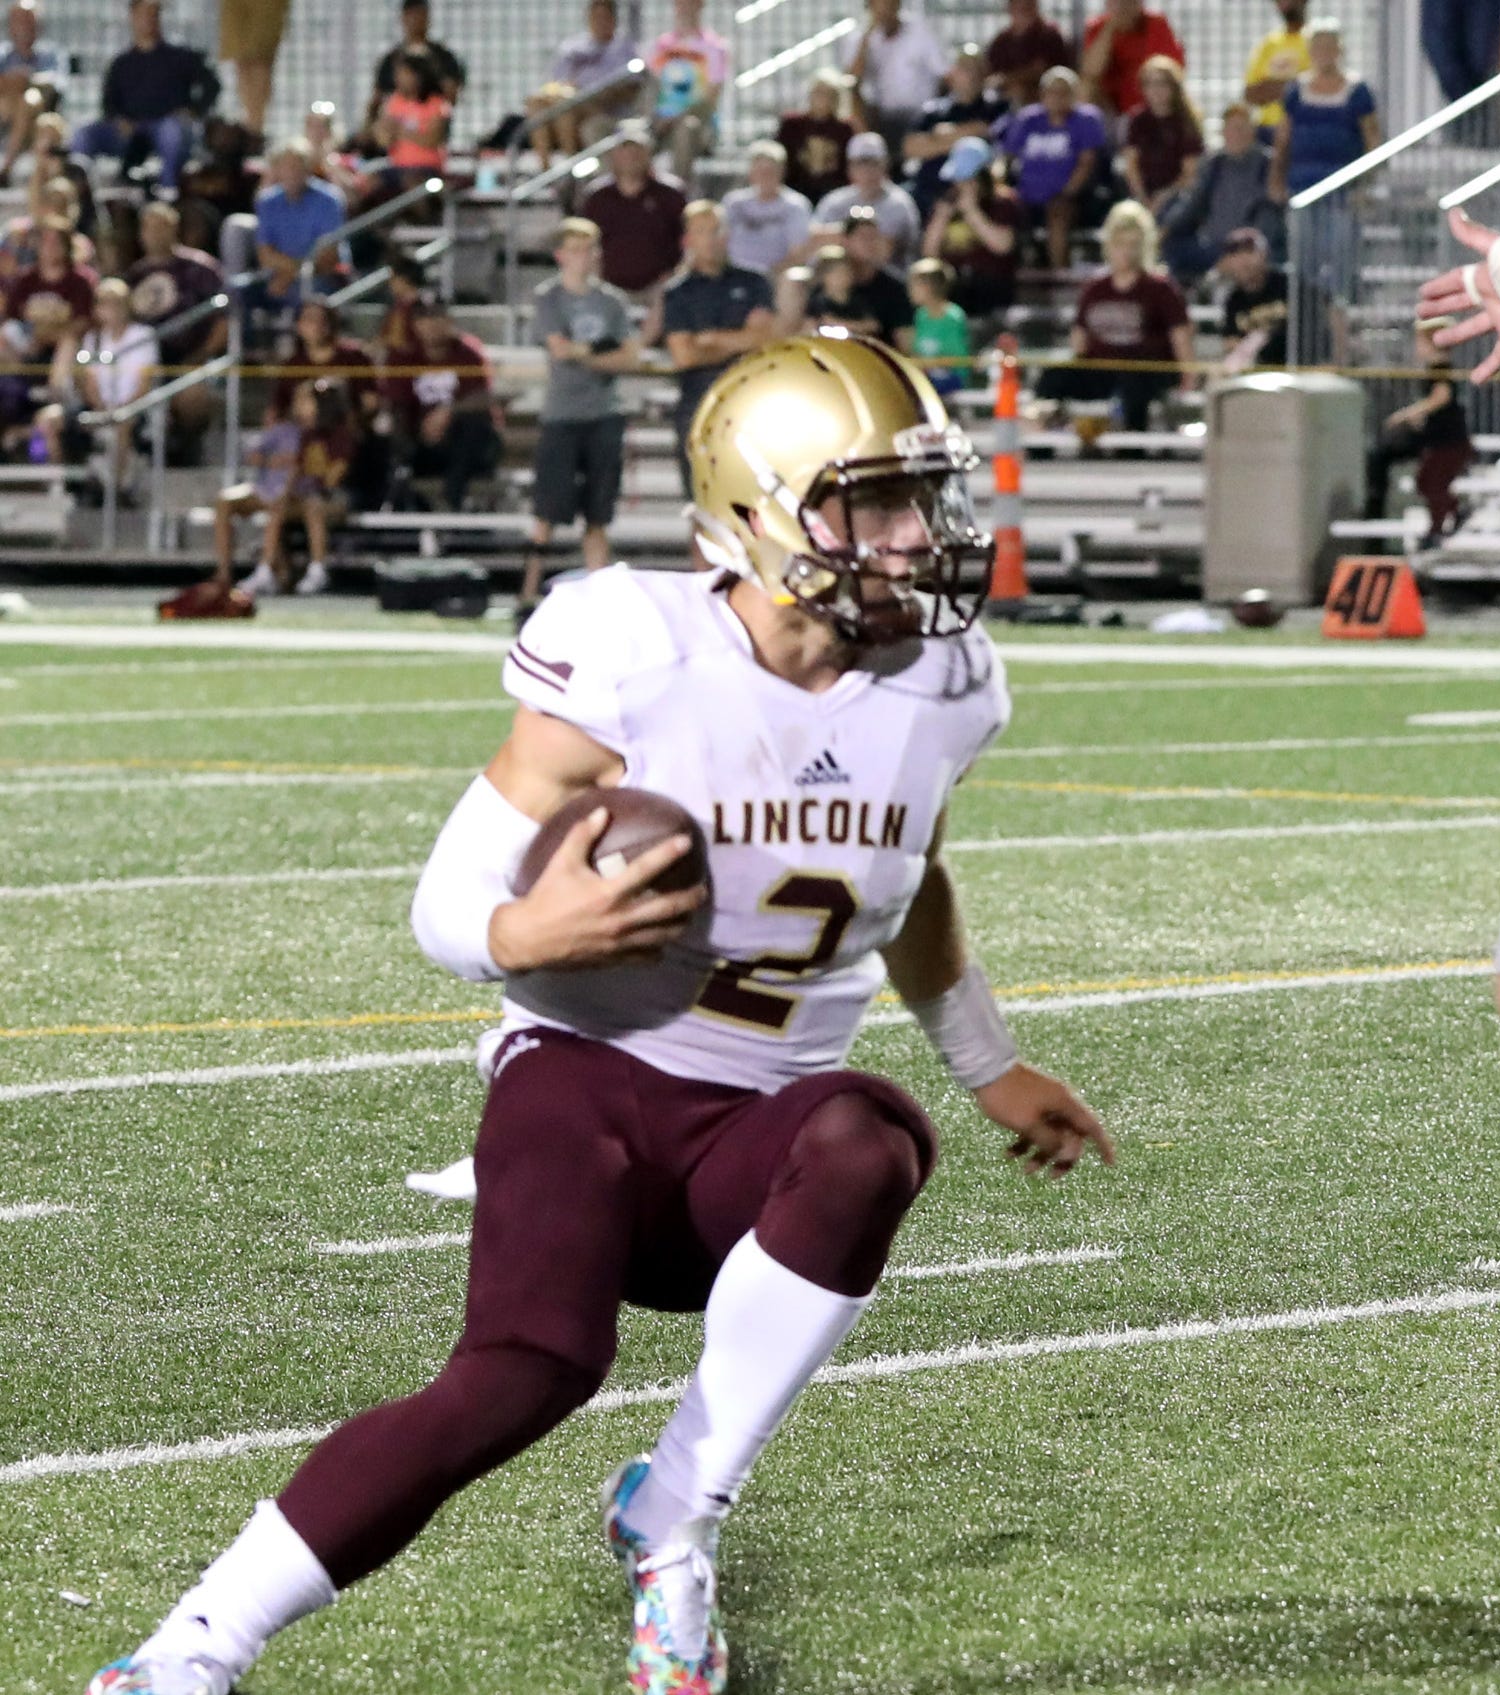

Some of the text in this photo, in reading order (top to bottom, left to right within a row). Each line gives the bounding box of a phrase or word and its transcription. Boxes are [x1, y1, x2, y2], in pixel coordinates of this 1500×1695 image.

[1332, 565, 1395, 625] 40
[713, 799, 907, 847] LINCOLN
[693, 866, 862, 1038] 2
